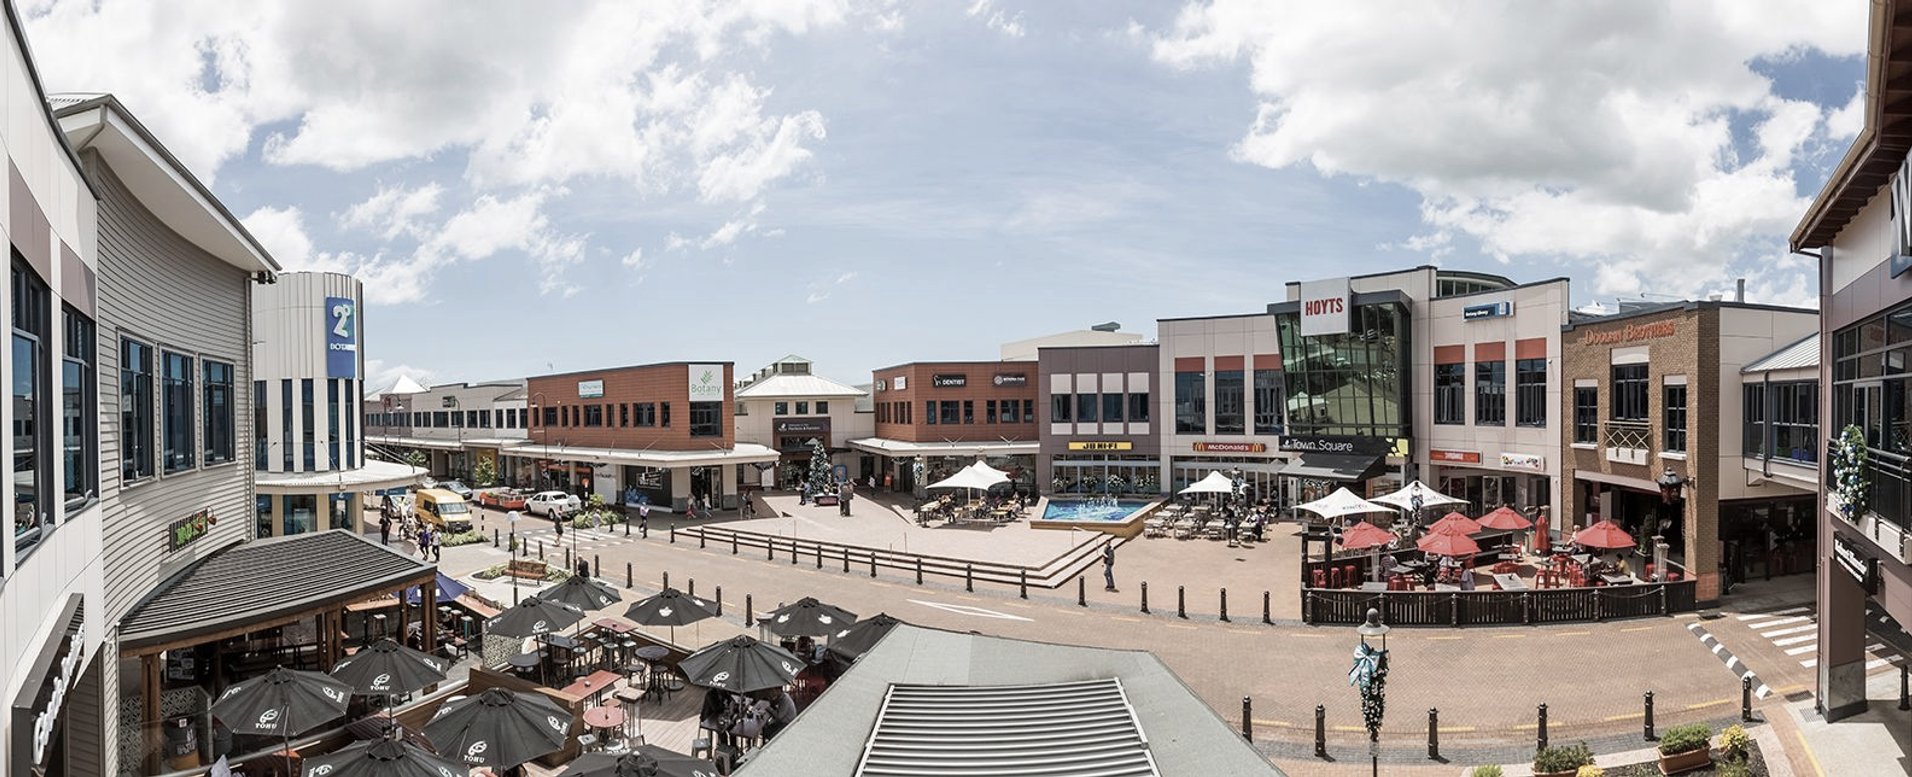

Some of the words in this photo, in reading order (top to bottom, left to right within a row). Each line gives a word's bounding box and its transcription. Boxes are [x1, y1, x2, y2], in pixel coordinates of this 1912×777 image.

[1305, 298, 1343, 316] HOYTS
[942, 378, 965, 386] DENTIST
[691, 383, 722, 395] Botany
[1291, 438, 1316, 450] Town
[1318, 439, 1354, 453] Square
[255, 722, 278, 730] TOHU
[463, 754, 485, 764] TOHU
